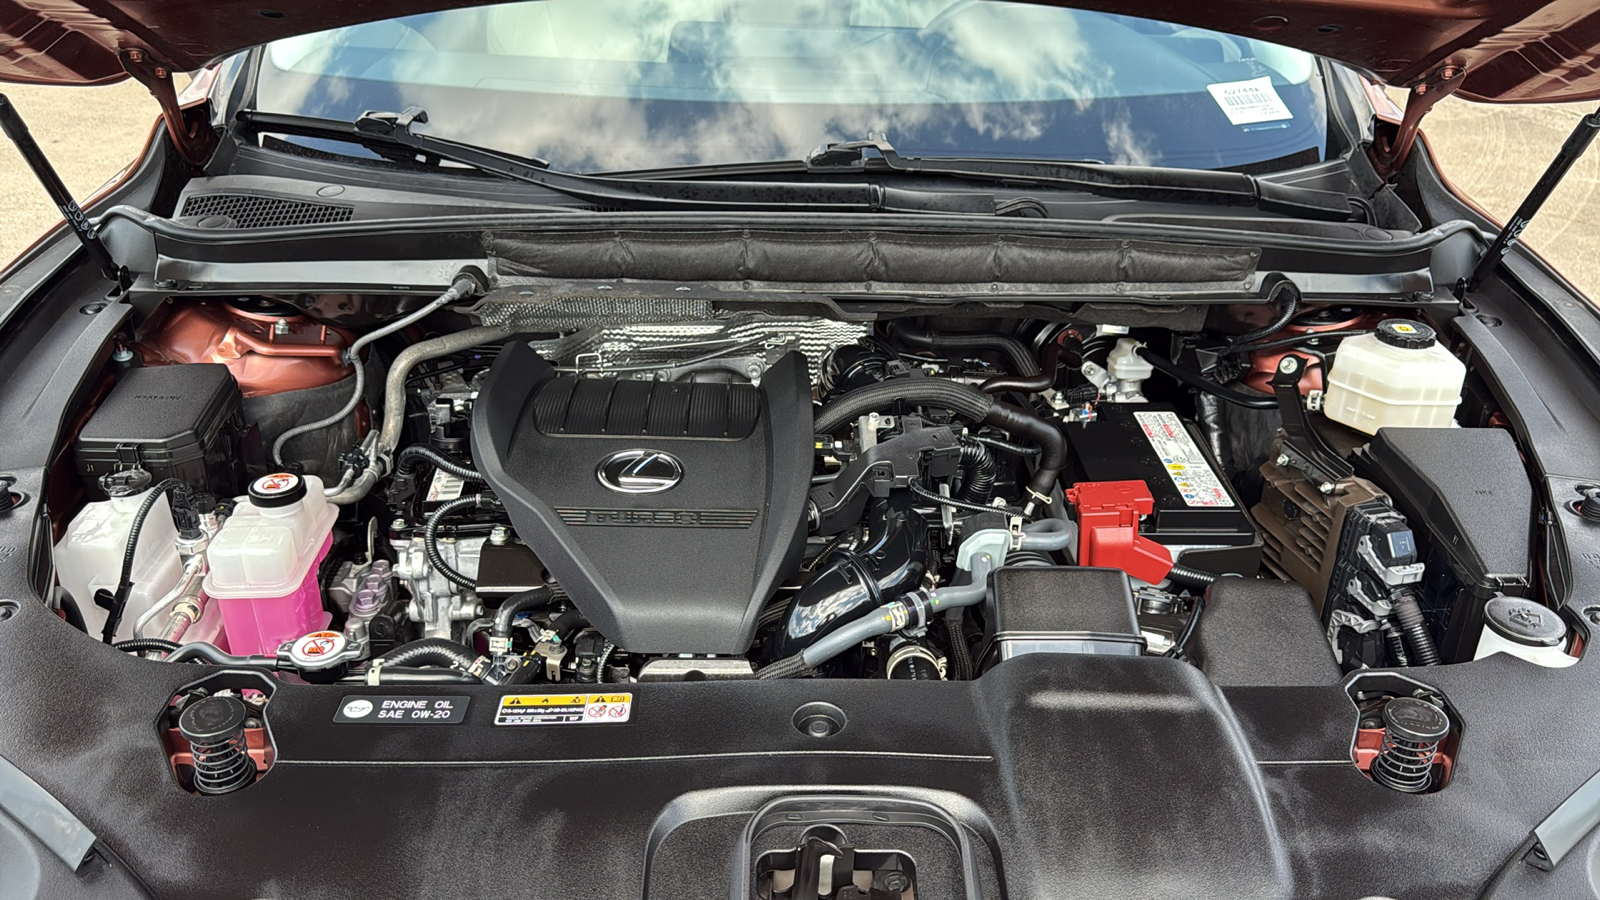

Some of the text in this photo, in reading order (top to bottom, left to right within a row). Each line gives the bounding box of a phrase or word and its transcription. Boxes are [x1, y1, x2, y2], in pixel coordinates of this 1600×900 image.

[589, 510, 698, 525] TURBO
[381, 700, 453, 709] ENGINE OIL
[378, 710, 451, 718] SAE 0W-20
